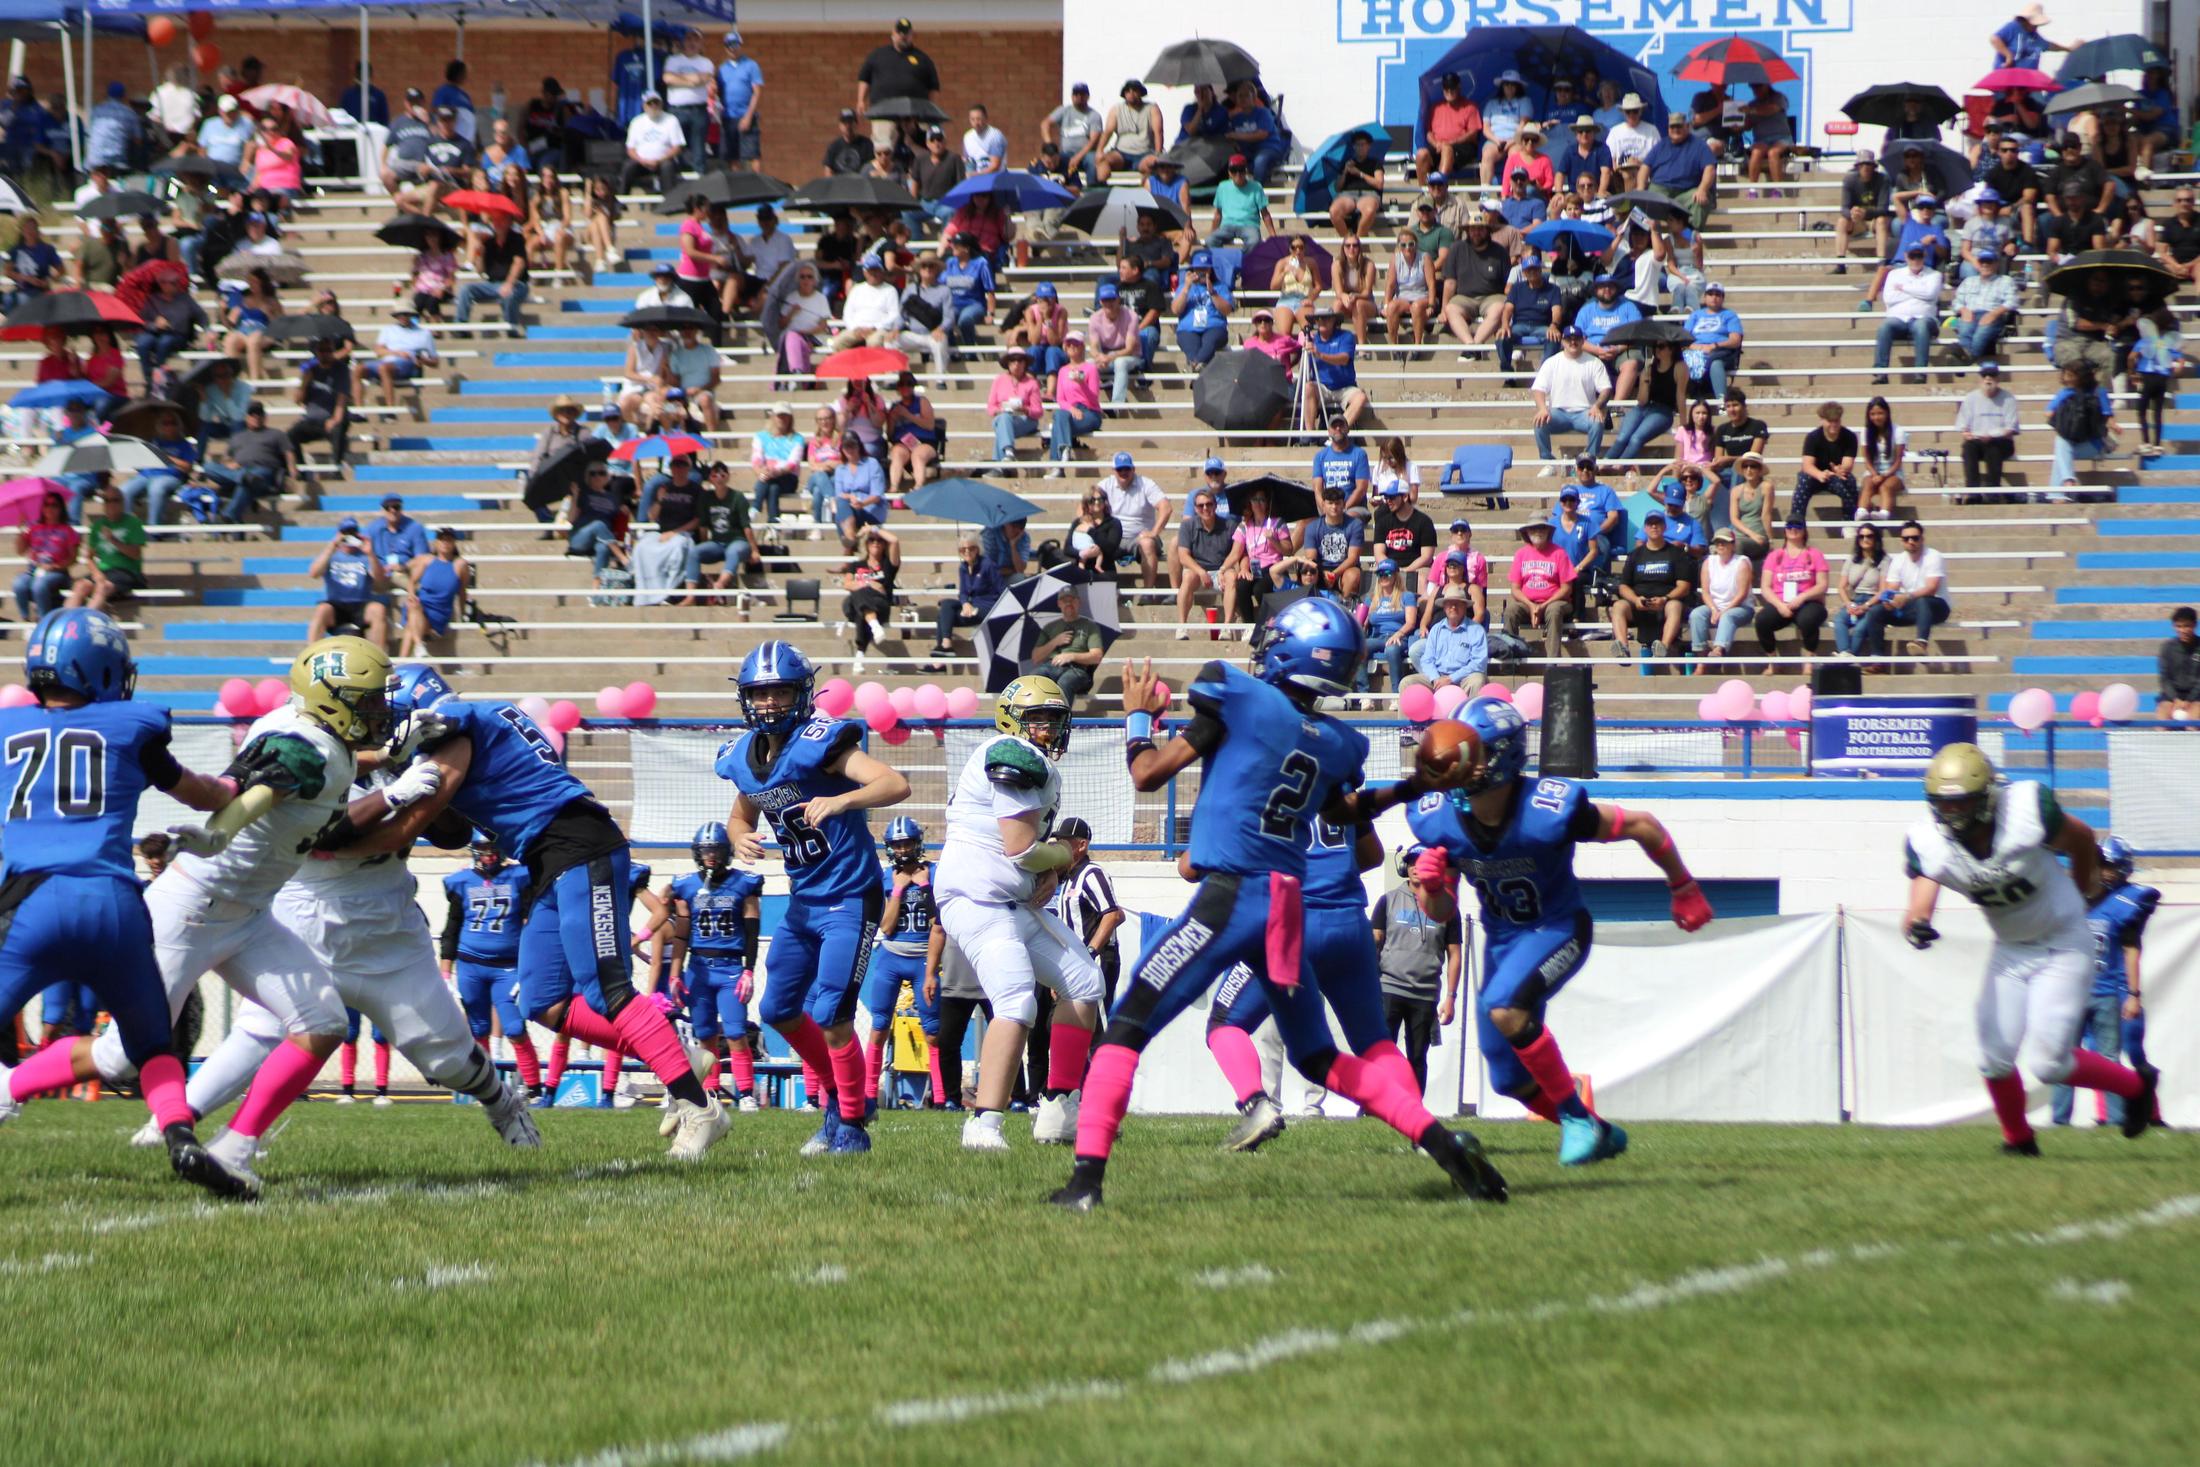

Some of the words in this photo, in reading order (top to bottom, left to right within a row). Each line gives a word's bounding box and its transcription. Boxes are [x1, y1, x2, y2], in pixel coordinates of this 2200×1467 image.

[1361, 0, 1827, 34] HORSEMEN
[46, 645, 57, 664] 8
[310, 650, 351, 687] H
[1847, 718, 1932, 730] HORSEMEN
[1848, 731, 1931, 745] FOOTBALL
[1845, 747, 1933, 756] BROTHERHOOD
[4, 727, 107, 823] 70
[1259, 749, 1320, 842] 2
[1531, 778, 1572, 814] 13
[764, 803, 835, 868] 56
[469, 895, 513, 934] 77
[1473, 876, 1542, 925] 13
[593, 885, 617, 959] HORSEMEN
[696, 907, 735, 938] 44
[1139, 917, 1214, 992] HORSEMEN
